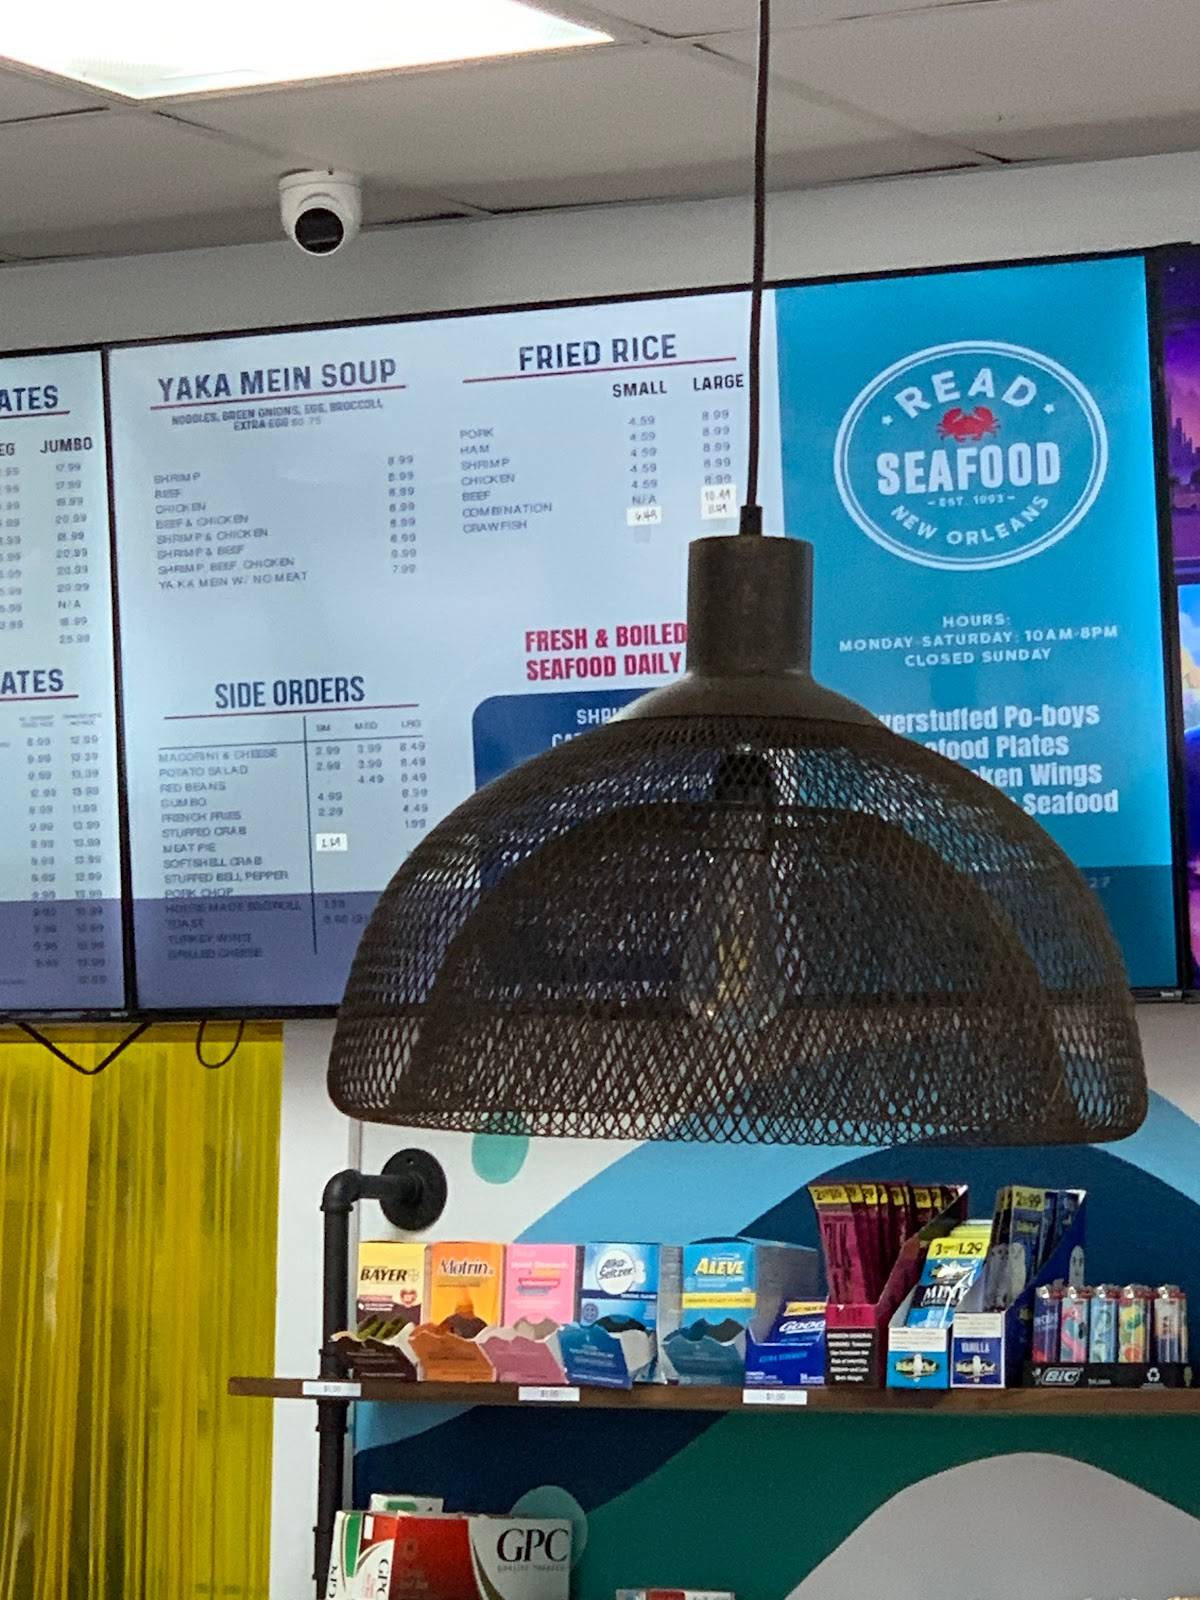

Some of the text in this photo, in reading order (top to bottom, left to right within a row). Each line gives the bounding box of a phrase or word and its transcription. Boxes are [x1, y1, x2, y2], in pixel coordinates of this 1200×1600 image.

[519, 334, 677, 371] FRIED RICE
[158, 358, 396, 402] YAKA MEIN SOUP
[612, 373, 744, 397] SMALL LARGE
[894, 367, 1037, 419] READ
[234, 418, 265, 431] EXTRA
[460, 427, 494, 439] PORK
[40, 436, 93, 454] JUMBO
[460, 444, 490, 455] HAM
[460, 458, 510, 471] SHRIMP
[876, 442, 1061, 496] SEAFOOD
[154, 472, 200, 484] SHRIMP
[461, 474, 516, 486] CHICKEN
[154, 488, 182, 499] BEEF
[462, 490, 491, 502] BEEF
[155, 502, 206, 514] CHICKEN
[462, 503, 552, 518] COMBINATION
[155, 514, 249, 529] BEEF & CHICKEN
[463, 520, 527, 533] CRAWFISH
[891, 495, 1050, 546] NEW ORLEANS
[156, 532, 202, 545] SHRIMP
[216, 528, 268, 541] CHICKEN
[157, 547, 203, 560] SHRIMP
[217, 545, 245, 556] BEEF
[243, 557, 295, 569] CHICKEN
[199, 577, 228, 588] MEIN
[525, 622, 687, 653] FRESH & BOILED
[904, 648, 1052, 667] CLOSED SUNDAY
[526, 652, 682, 681] SEAFOOD DAILY
[215, 675, 365, 709] SIDE ORDERS
[878, 703, 1100, 735] verstuffed Po-boys
[234, 748, 277, 759] CHEESE
[925, 734, 1070, 761] food Plates
[159, 765, 248, 777] POTATO SALAD
[1030, 763, 1103, 787] Wings
[185, 781, 226, 792] BEANS
[161, 797, 207, 808] GUMBO
[1023, 789, 1119, 816] Seafood
[161, 812, 207, 823] FRENCH
[162, 826, 247, 838] STUFFED CRAB
[162, 843, 195, 853] MEAT
[229, 856, 263, 867] CRAB
[164, 870, 289, 883] STUFFED BELL PEPPER
[935, 1242, 983, 1256] 3 1.29
[360, 1266, 409, 1282] BAYER
[441, 1258, 490, 1277] Motrin
[599, 1266, 635, 1280] Seltzer
[694, 1257, 745, 1278] ALEVE
[961, 1342, 990, 1354] VANILLA
[1046, 1370, 1078, 1381] BIC
[497, 1528, 569, 1563] GPC
